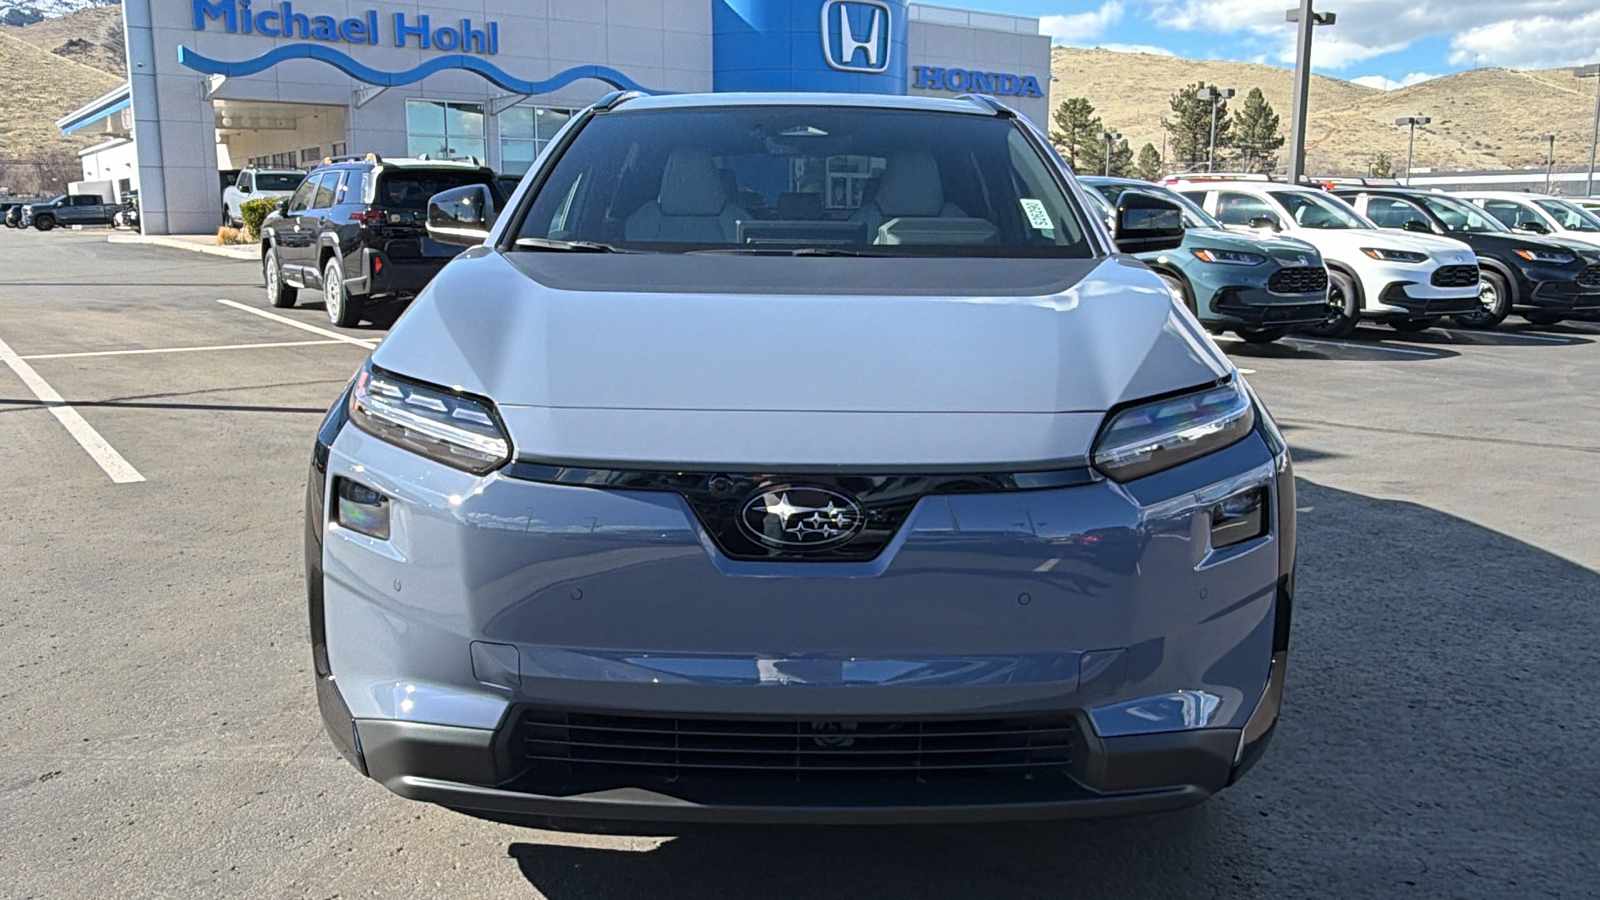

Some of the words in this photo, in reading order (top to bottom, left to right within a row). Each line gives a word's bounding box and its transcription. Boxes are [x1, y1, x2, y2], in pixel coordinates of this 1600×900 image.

[193, 0, 378, 45] Michael
[394, 12, 498, 54] Hohl
[913, 65, 1044, 98] HONDA
